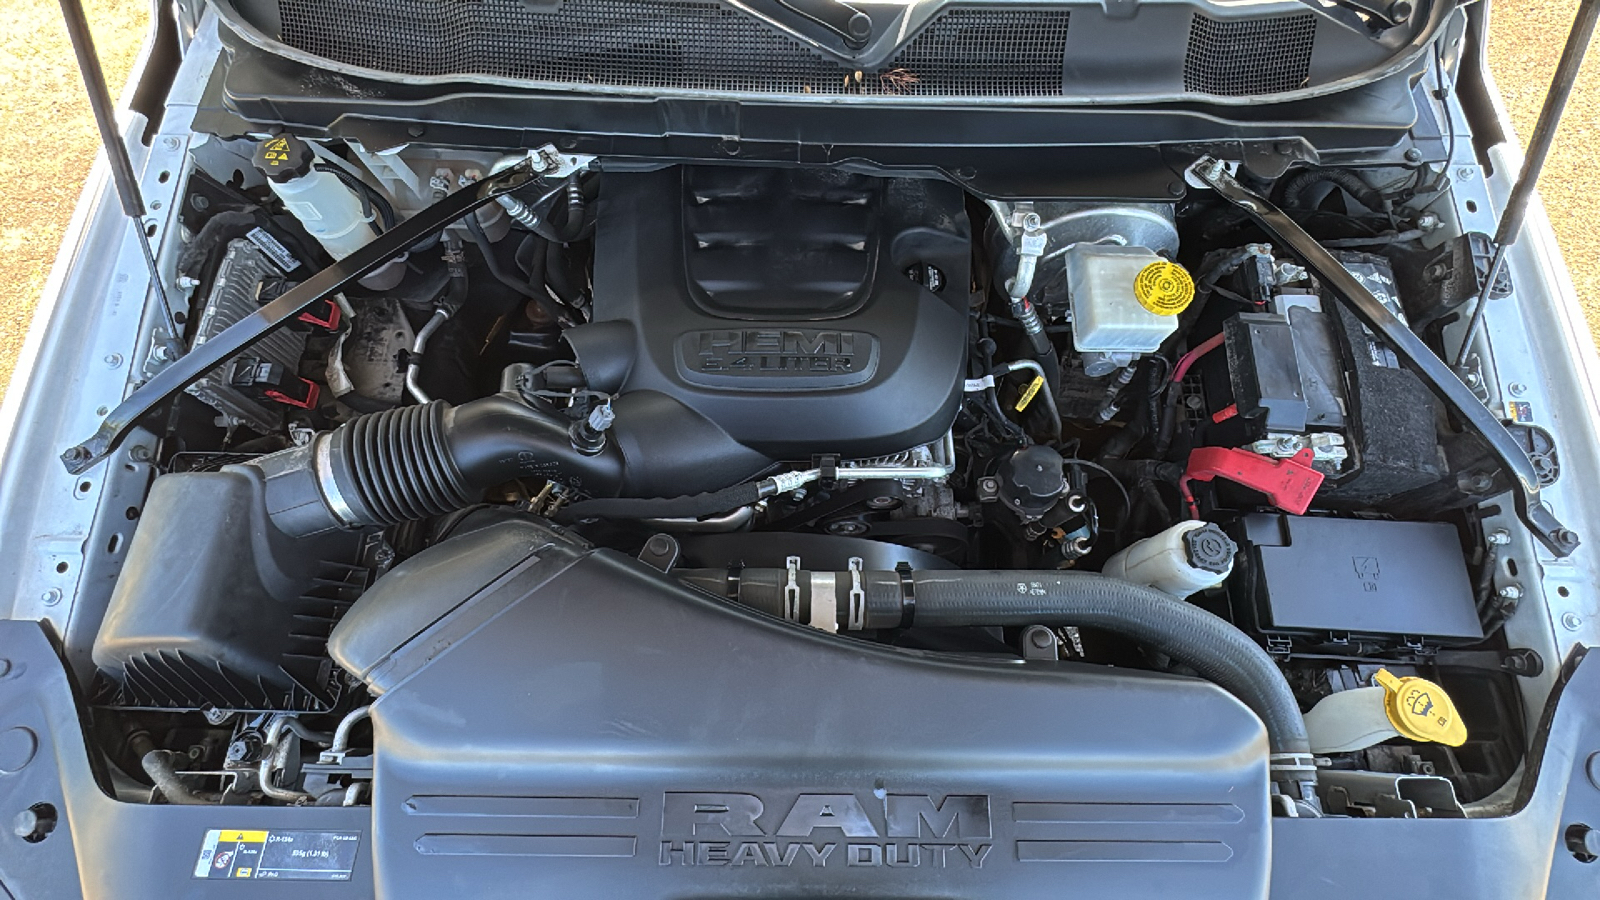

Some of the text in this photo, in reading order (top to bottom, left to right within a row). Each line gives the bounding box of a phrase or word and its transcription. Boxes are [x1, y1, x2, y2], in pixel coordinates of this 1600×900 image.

[698, 331, 855, 356] HEMI
[661, 791, 993, 839] RAM
[658, 841, 993, 868] HEAVY DUTY
